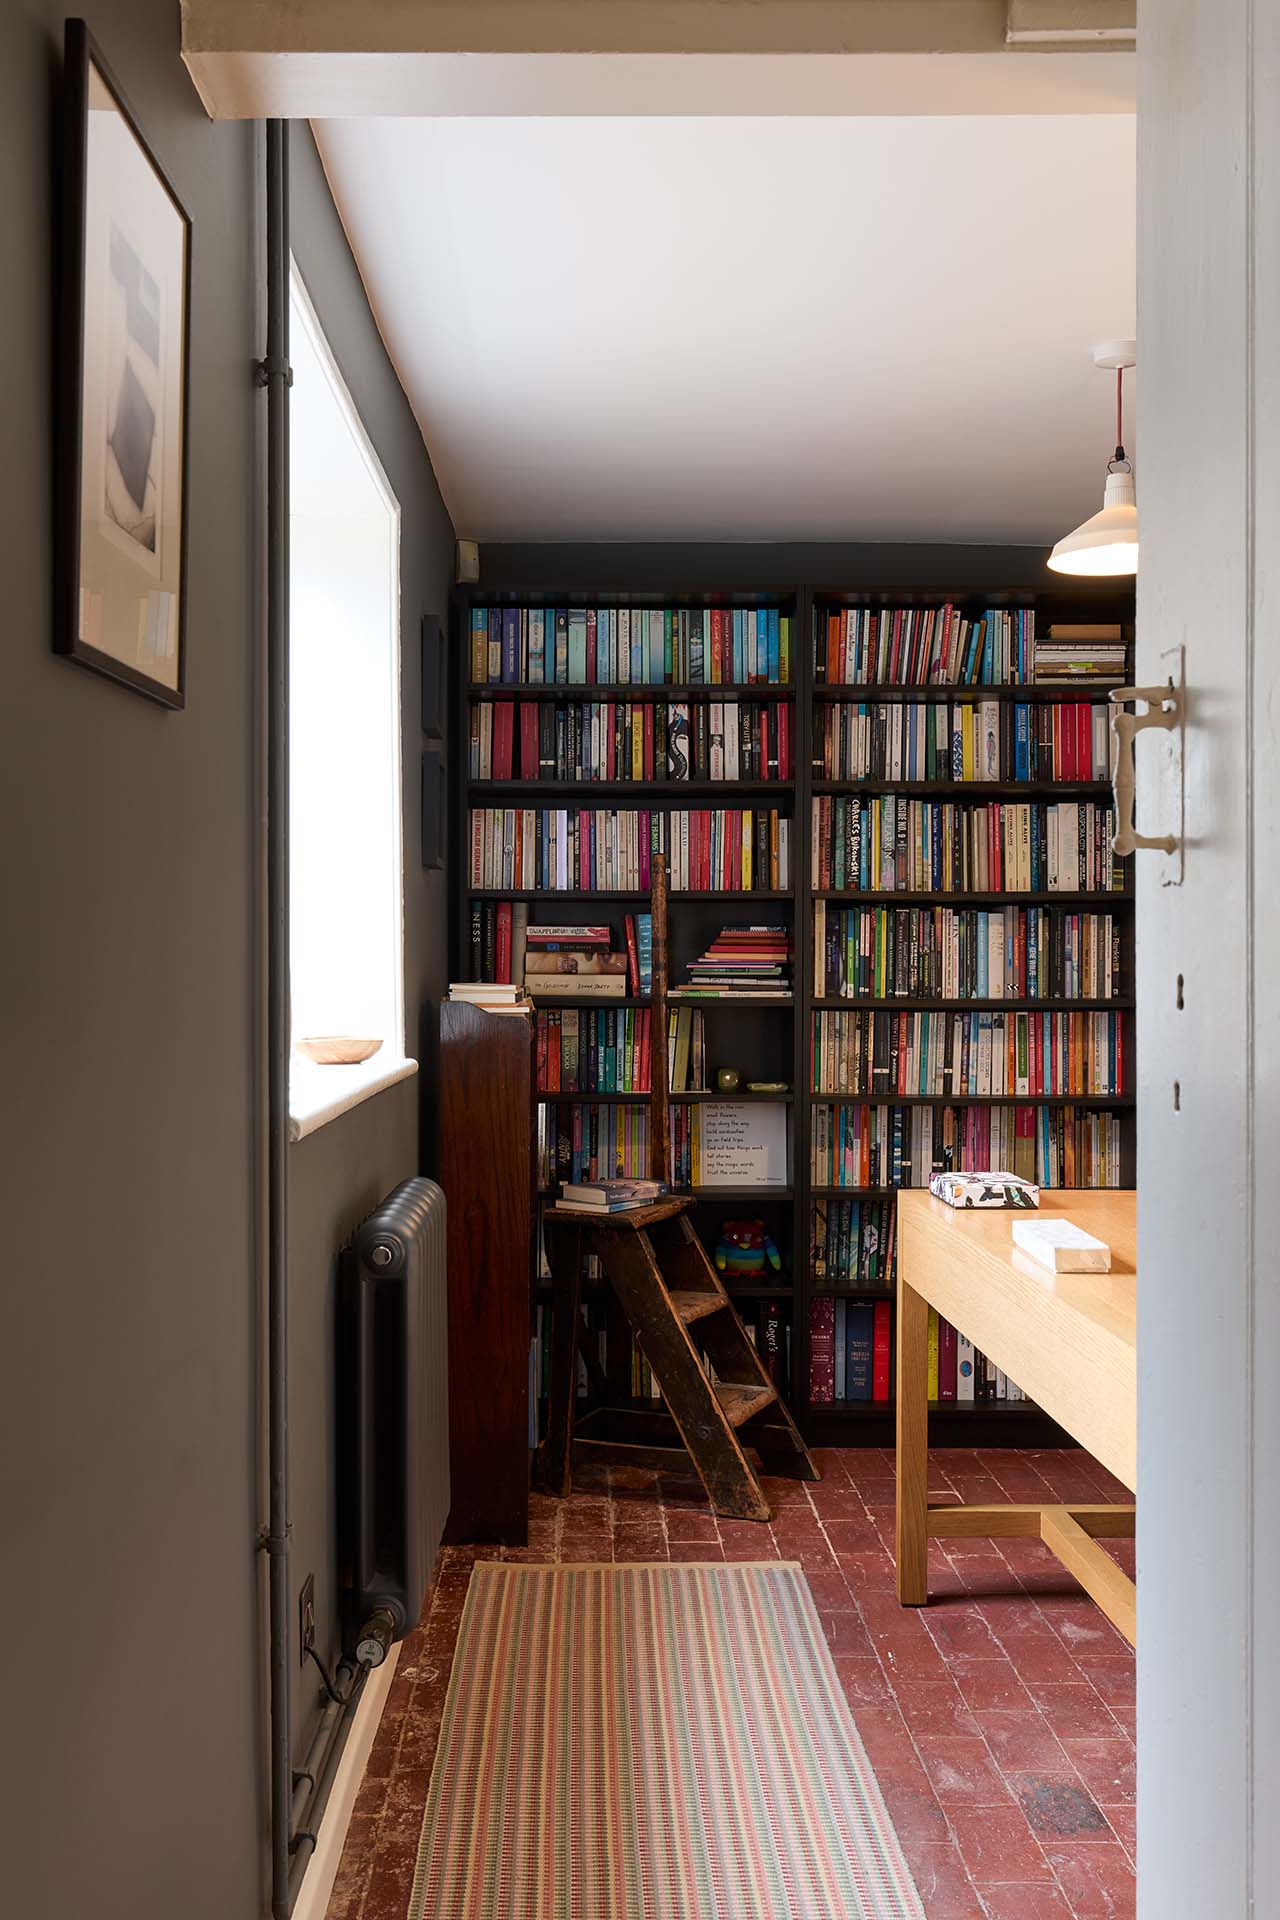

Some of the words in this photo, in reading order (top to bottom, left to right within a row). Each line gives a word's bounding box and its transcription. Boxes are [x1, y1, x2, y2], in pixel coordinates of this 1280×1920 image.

[898, 800, 906, 820] INSIDE
[1112, 938, 1120, 962] Rankin
[766, 1320, 779, 1352] Roget's
